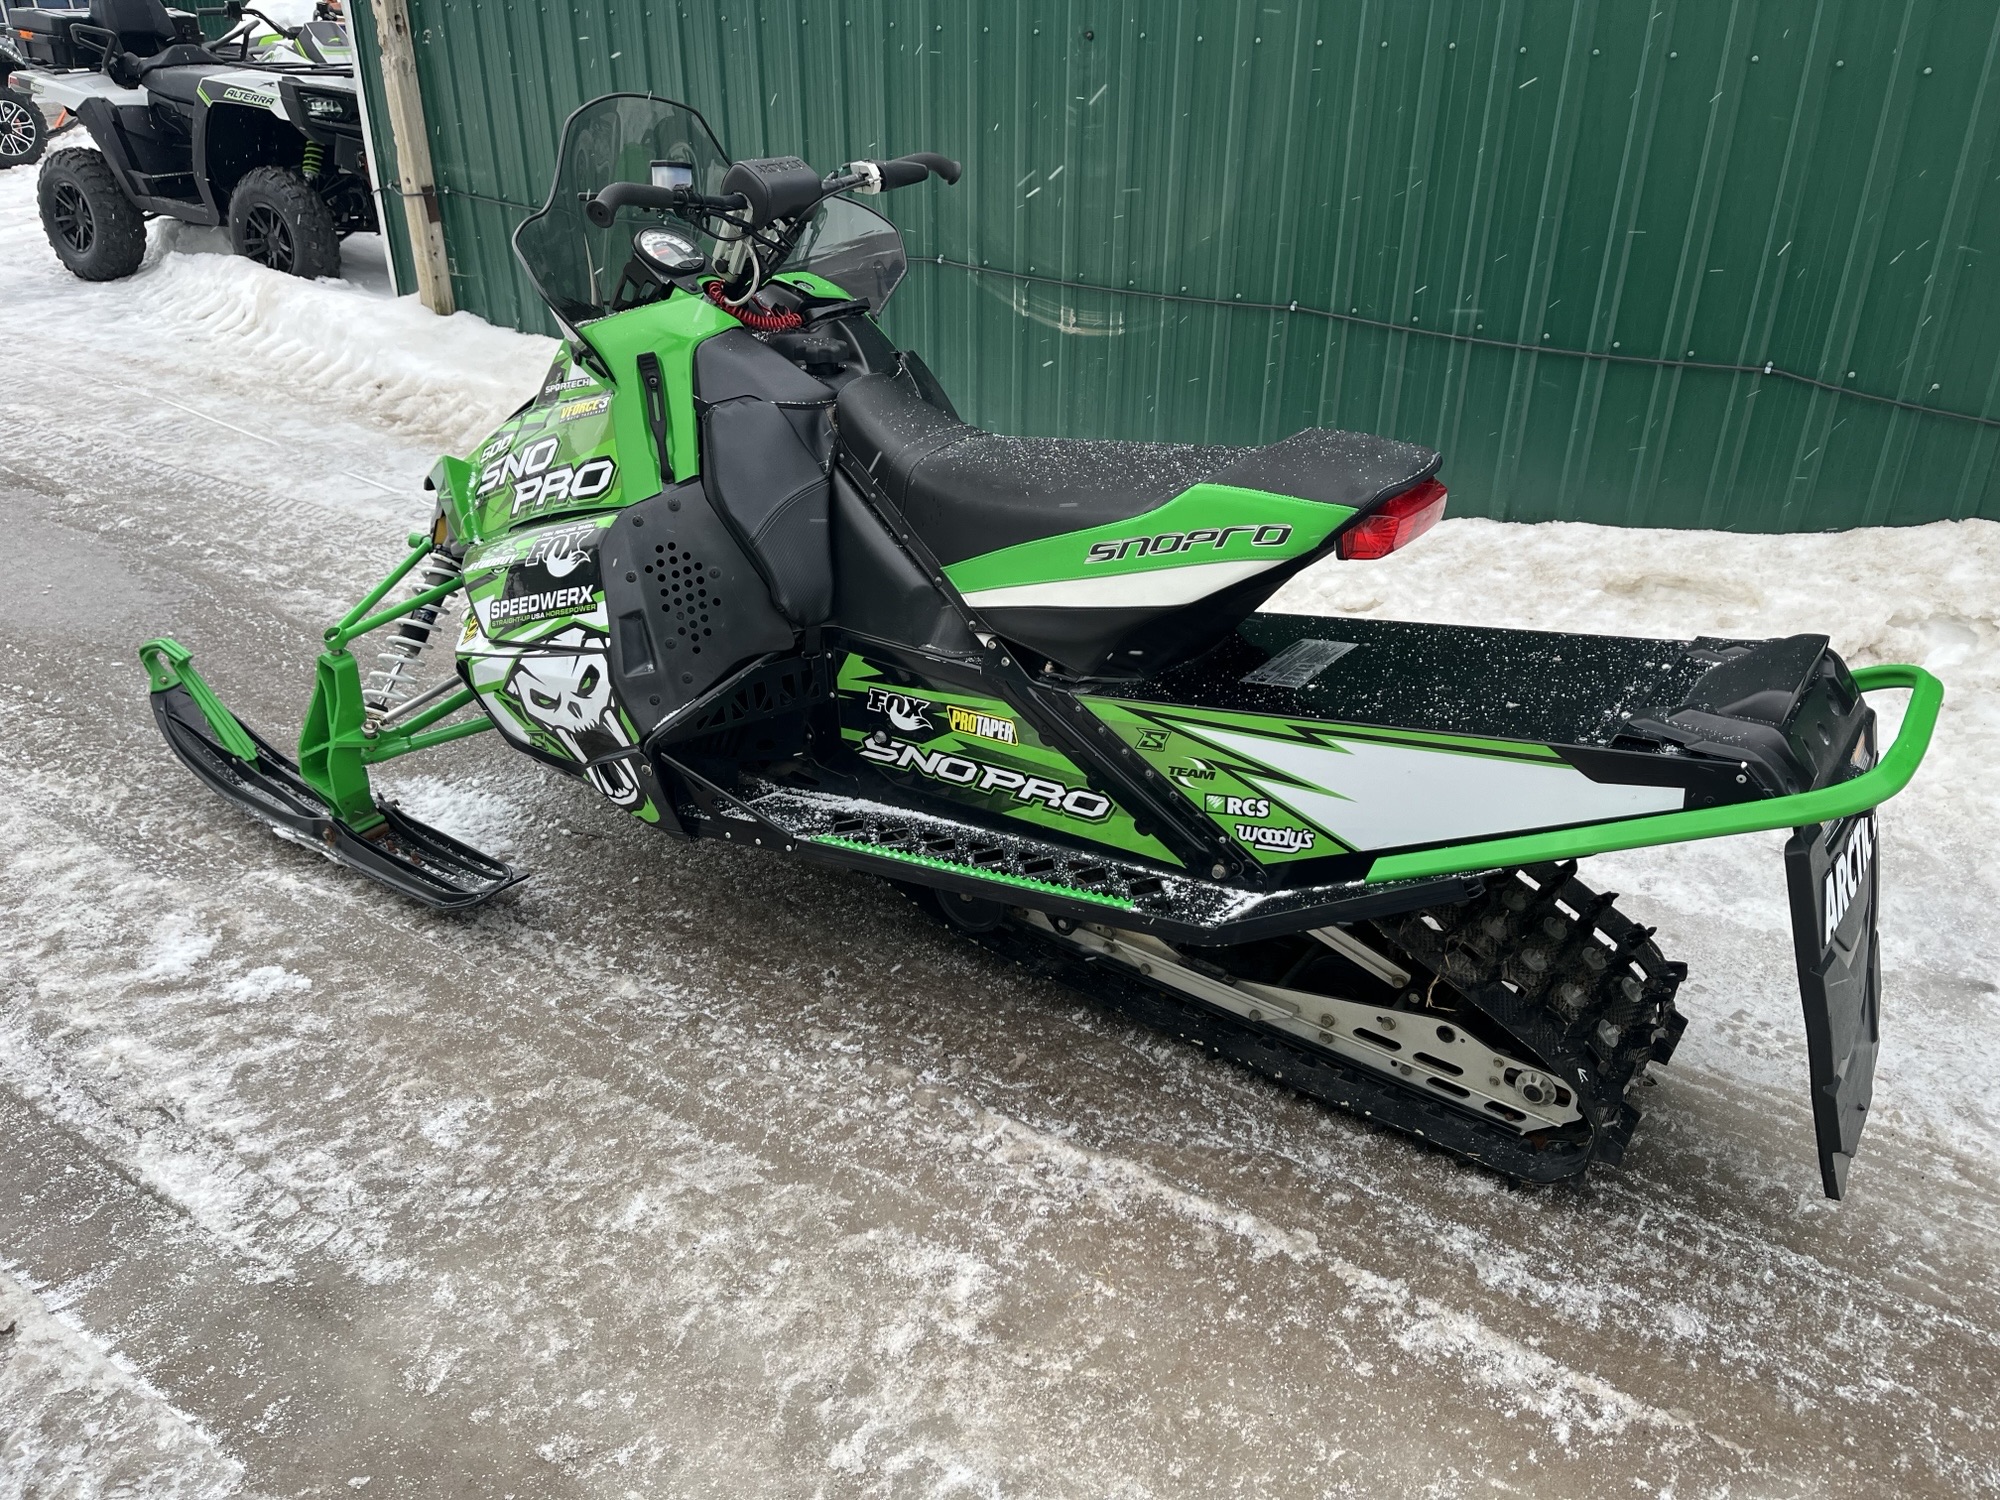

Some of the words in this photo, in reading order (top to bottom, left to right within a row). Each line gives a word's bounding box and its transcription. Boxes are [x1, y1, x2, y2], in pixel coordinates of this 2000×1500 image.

[226, 89, 275, 105] ALTERRA
[545, 378, 590, 394] SPORTECH
[480, 433, 515, 463] 500
[477, 438, 559, 495] SNO
[512, 460, 614, 515] PRO
[525, 529, 595, 572] FOX
[491, 585, 594, 619] SPEEDWERX
[492, 614, 530, 626] STRAIGHT-UP
[530, 612, 545, 620] USA
[545, 603, 596, 617] HORSEPOWER
[867, 688, 931, 726] FOX
[1168, 766, 1216, 780] TEAM
[1227, 797, 1269, 817] RCS
[1825, 817, 1872, 946] ARCTIC
